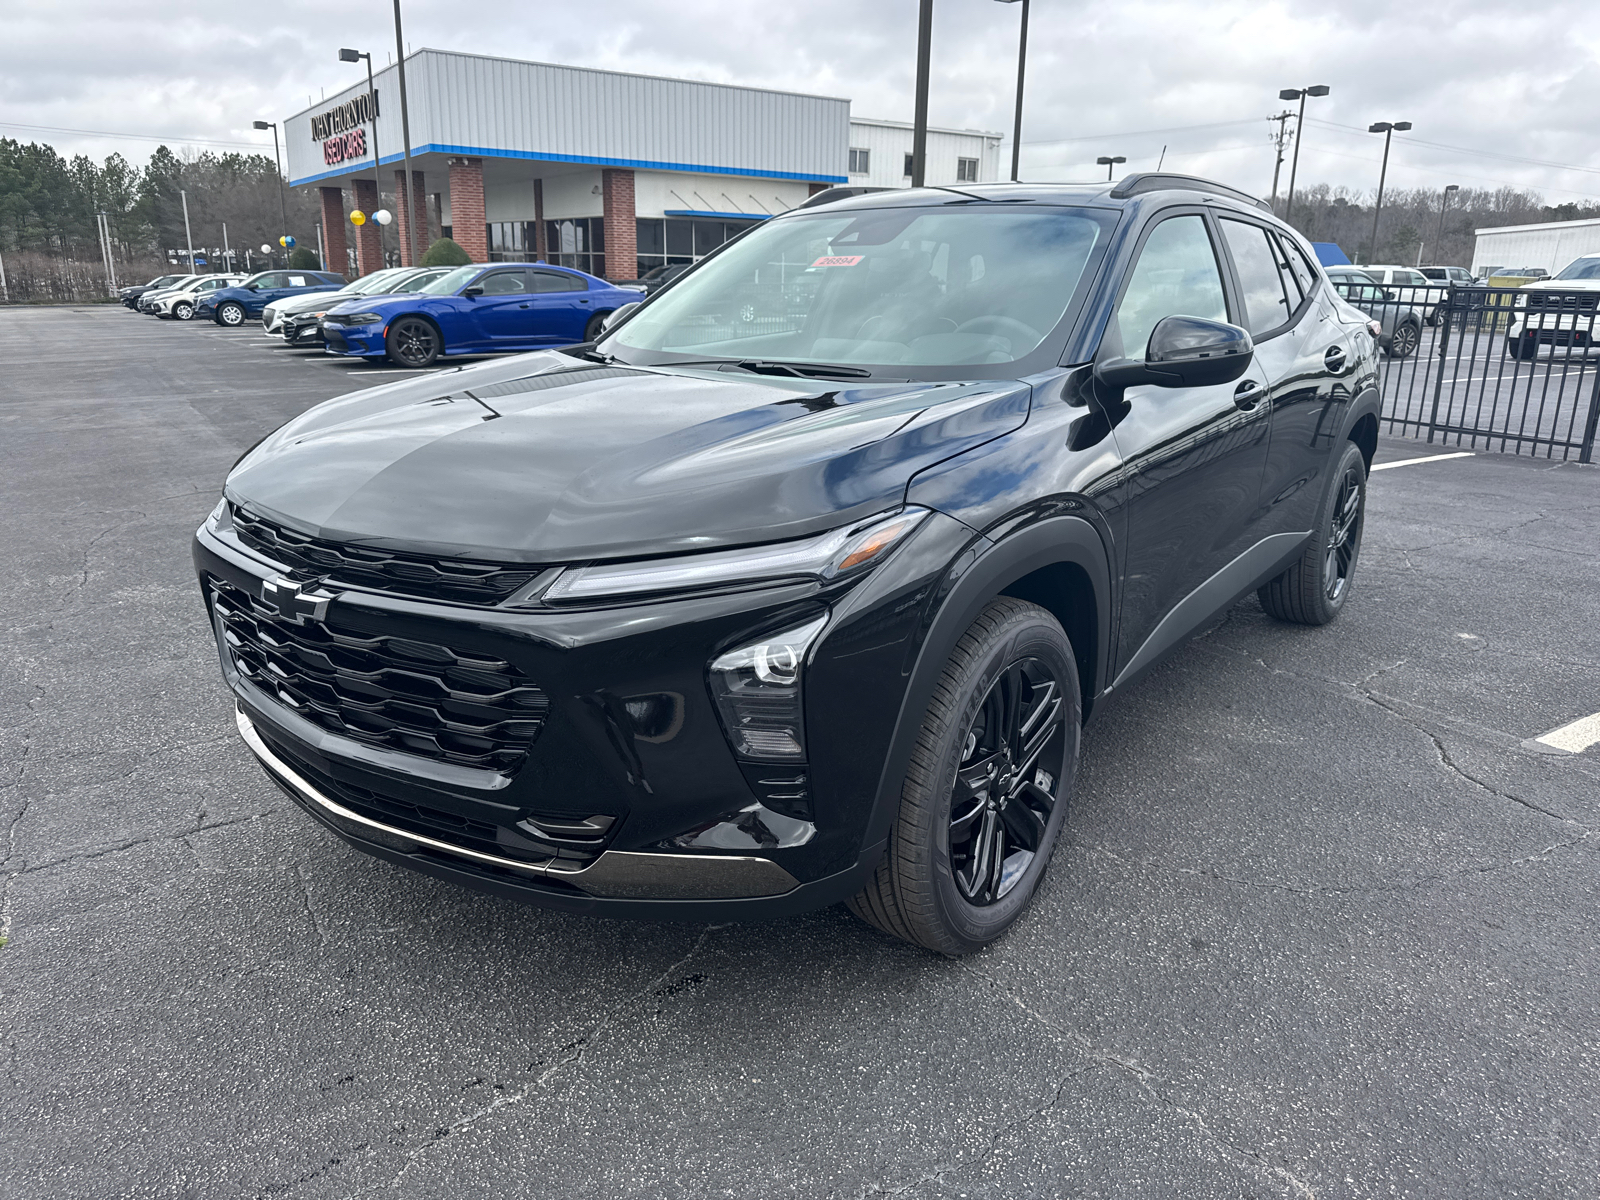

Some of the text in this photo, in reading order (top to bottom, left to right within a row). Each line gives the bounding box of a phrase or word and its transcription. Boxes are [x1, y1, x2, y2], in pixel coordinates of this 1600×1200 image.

[310, 112, 332, 142] JOHN
[323, 128, 366, 165] USED CARS
[818, 256, 856, 265] 26894
